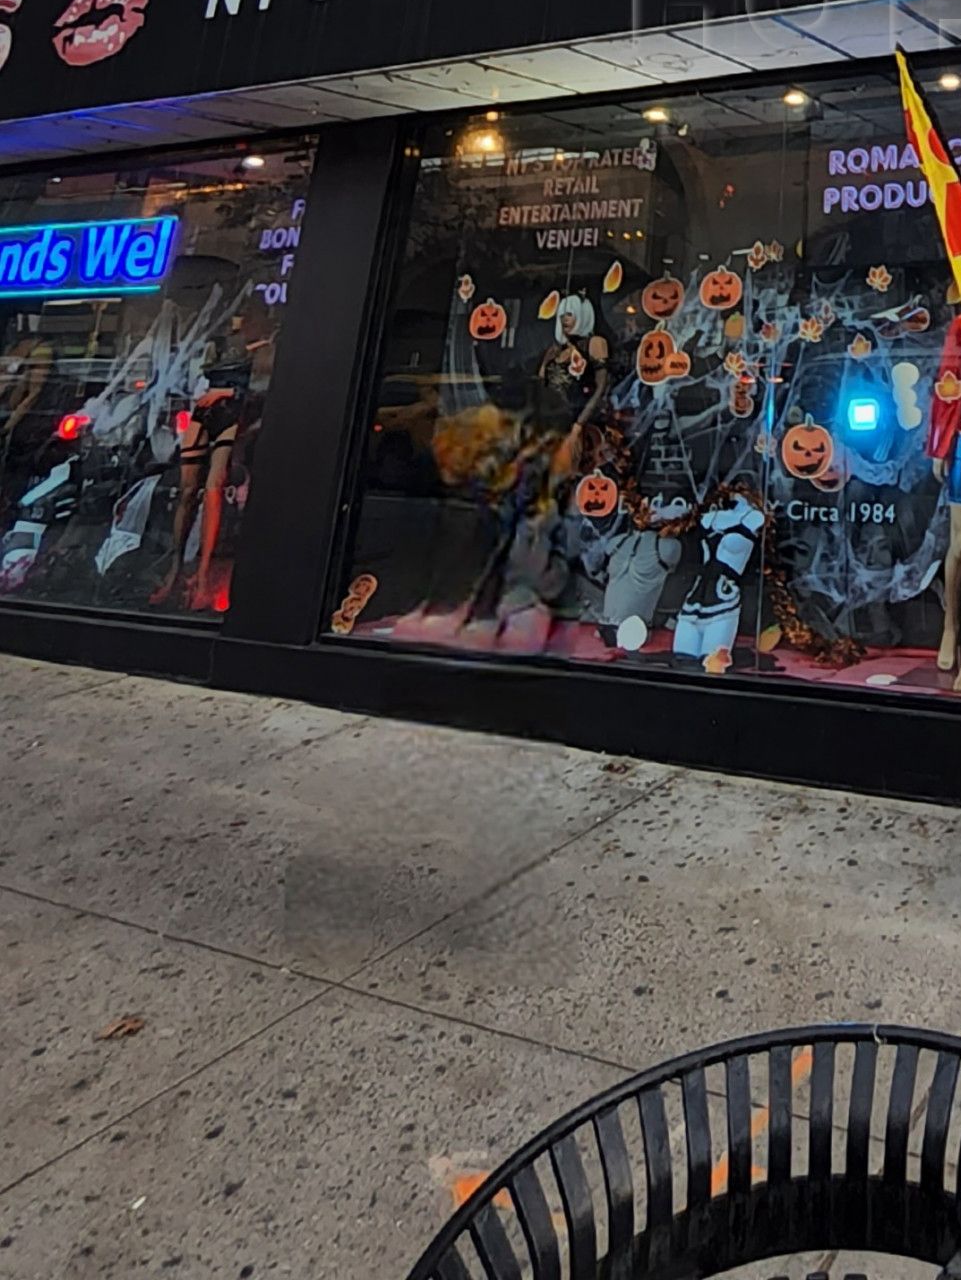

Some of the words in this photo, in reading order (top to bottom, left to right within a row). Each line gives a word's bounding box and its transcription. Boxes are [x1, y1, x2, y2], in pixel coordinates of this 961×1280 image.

[543, 177, 600, 197] RETAIL
[499, 198, 643, 225] ENTERTAINMENT
[786, 499, 839, 522] Circa
[850, 502, 896, 524] 1984
